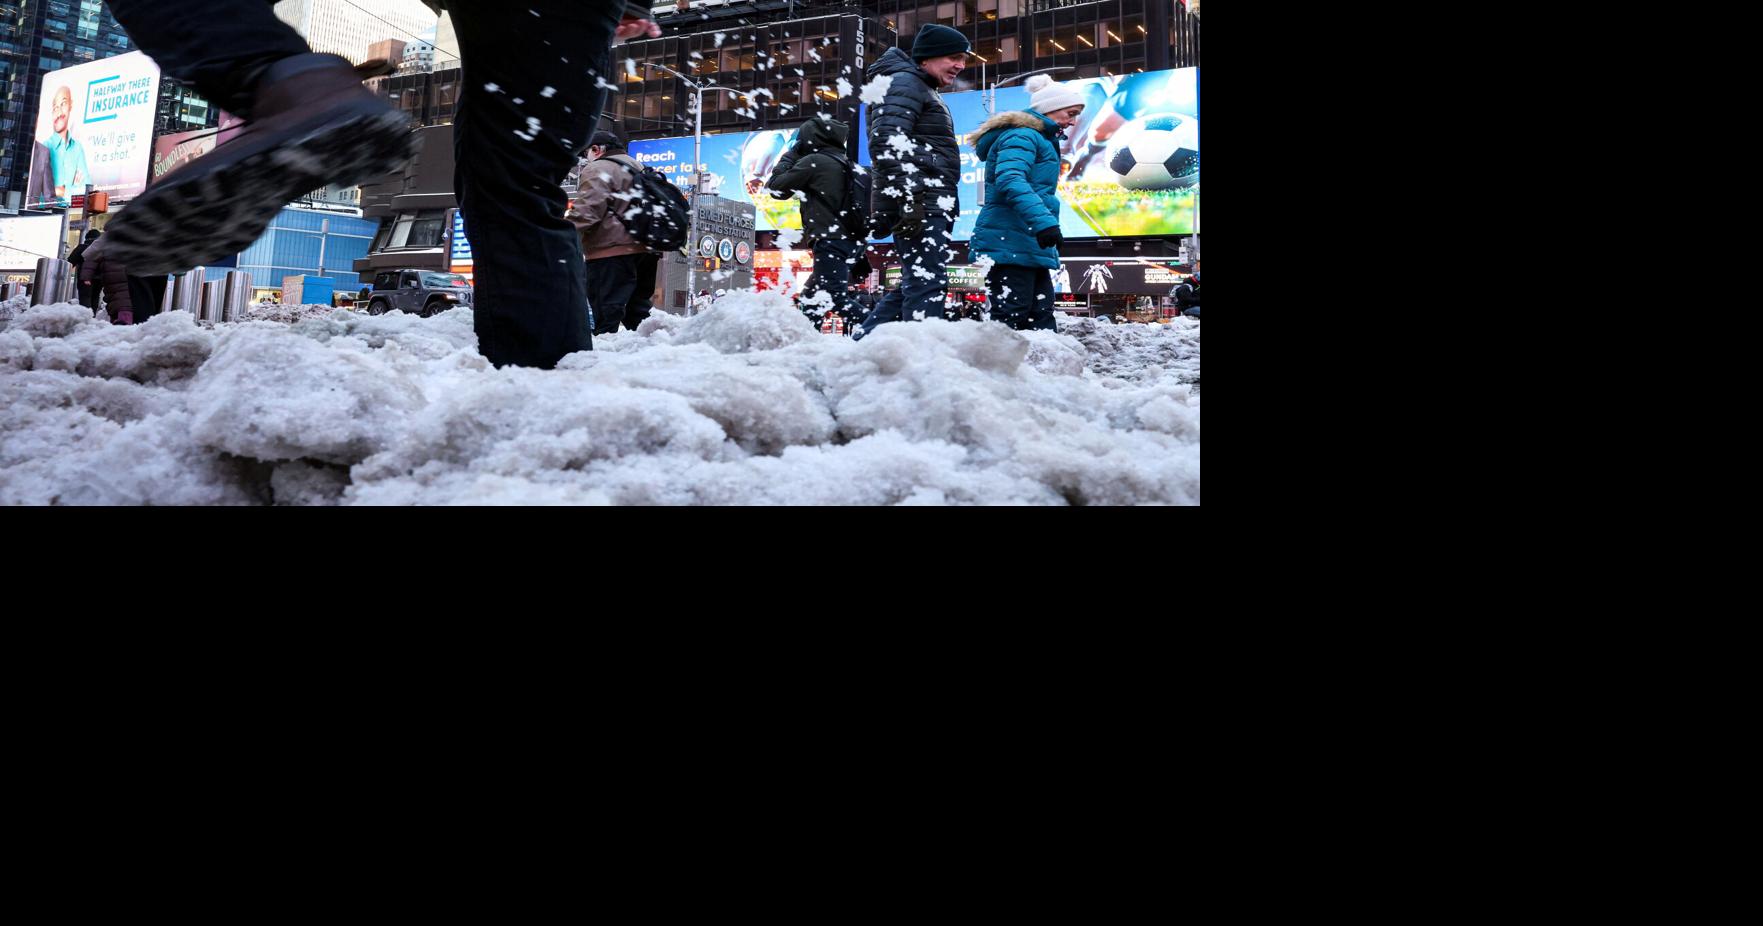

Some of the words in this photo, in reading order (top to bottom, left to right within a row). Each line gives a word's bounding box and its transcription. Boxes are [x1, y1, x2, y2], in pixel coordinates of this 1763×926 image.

[855, 18, 865, 70] 1500
[94, 81, 127, 97] HALFWAY
[128, 76, 151, 90] THERE
[91, 89, 150, 113] INSURANCE
[117, 131, 136, 148] give
[635, 150, 676, 162] Reach
[723, 213, 755, 230] FORCES
[723, 226, 750, 239] STATION
[948, 277, 979, 285] COFFEE
